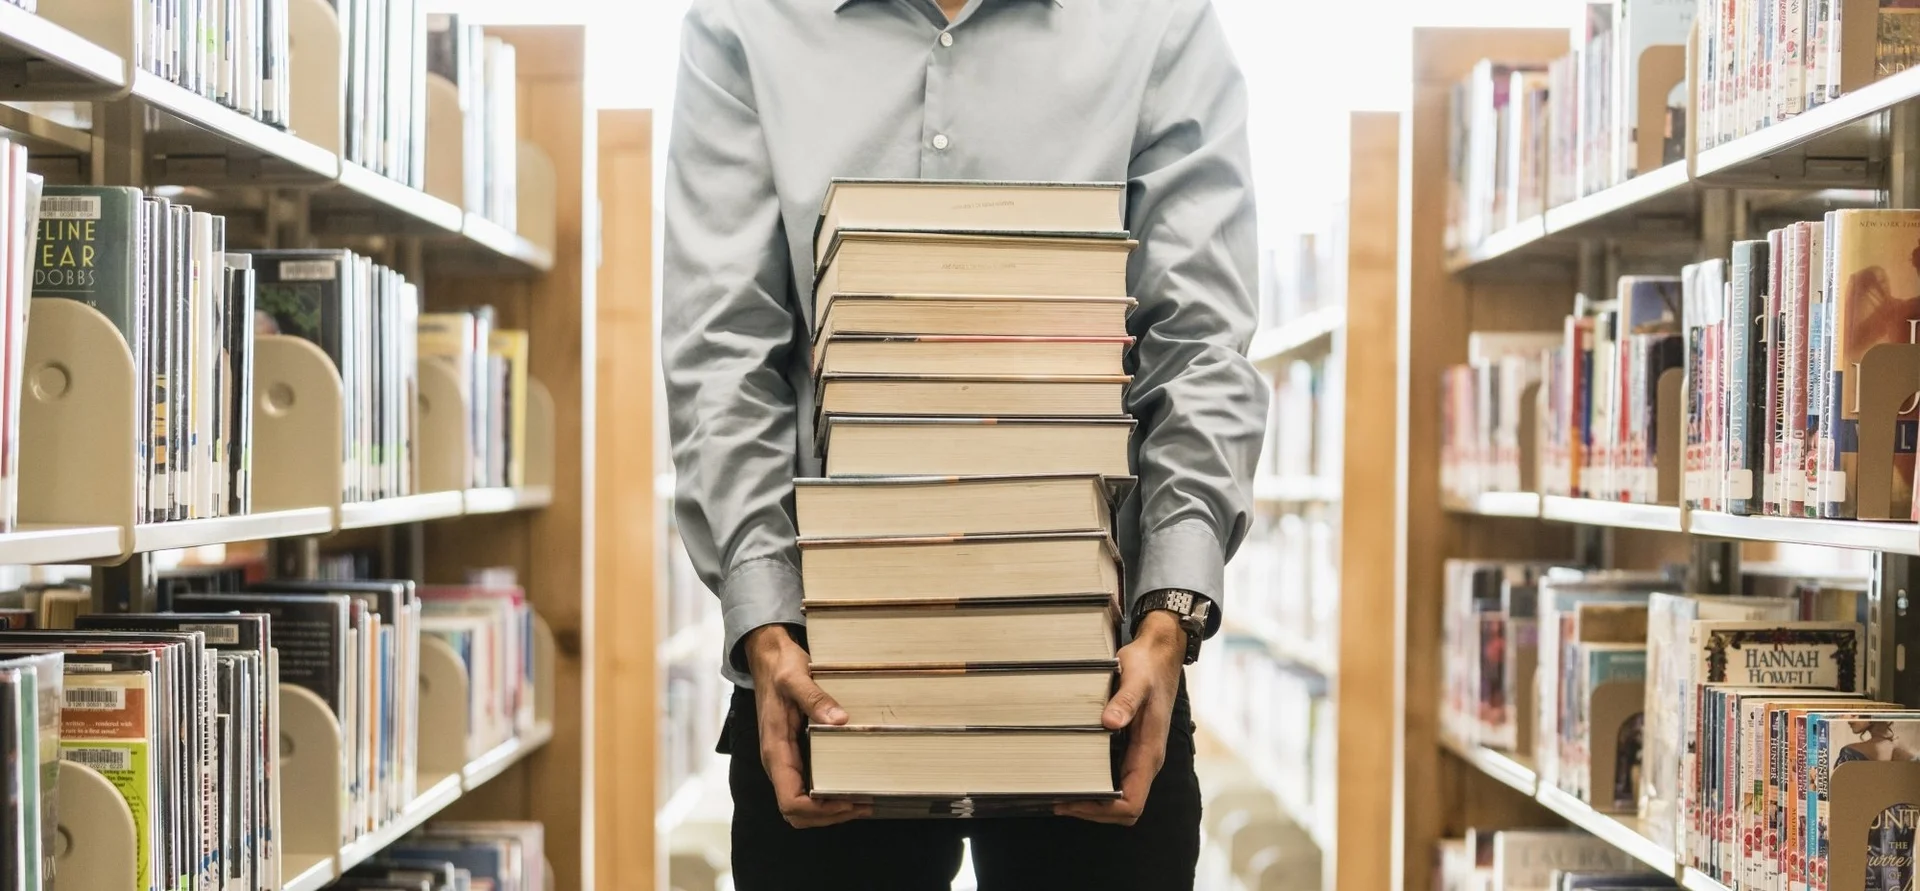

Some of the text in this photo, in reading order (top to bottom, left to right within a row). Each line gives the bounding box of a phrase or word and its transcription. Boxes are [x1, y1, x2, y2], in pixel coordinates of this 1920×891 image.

[35, 269, 95, 286] DOBBS
[1731, 262, 1749, 320] FINDING
[1731, 321, 1746, 361] LAURA
[1793, 229, 1807, 418] LINDA HOWARD
[1776, 340, 1786, 374] LINDA
[1775, 376, 1785, 426] HOWARD
[1745, 648, 1820, 669] HANNAH
[1770, 737, 1778, 780] HUNTER
[1888, 841, 1909, 850] THE
